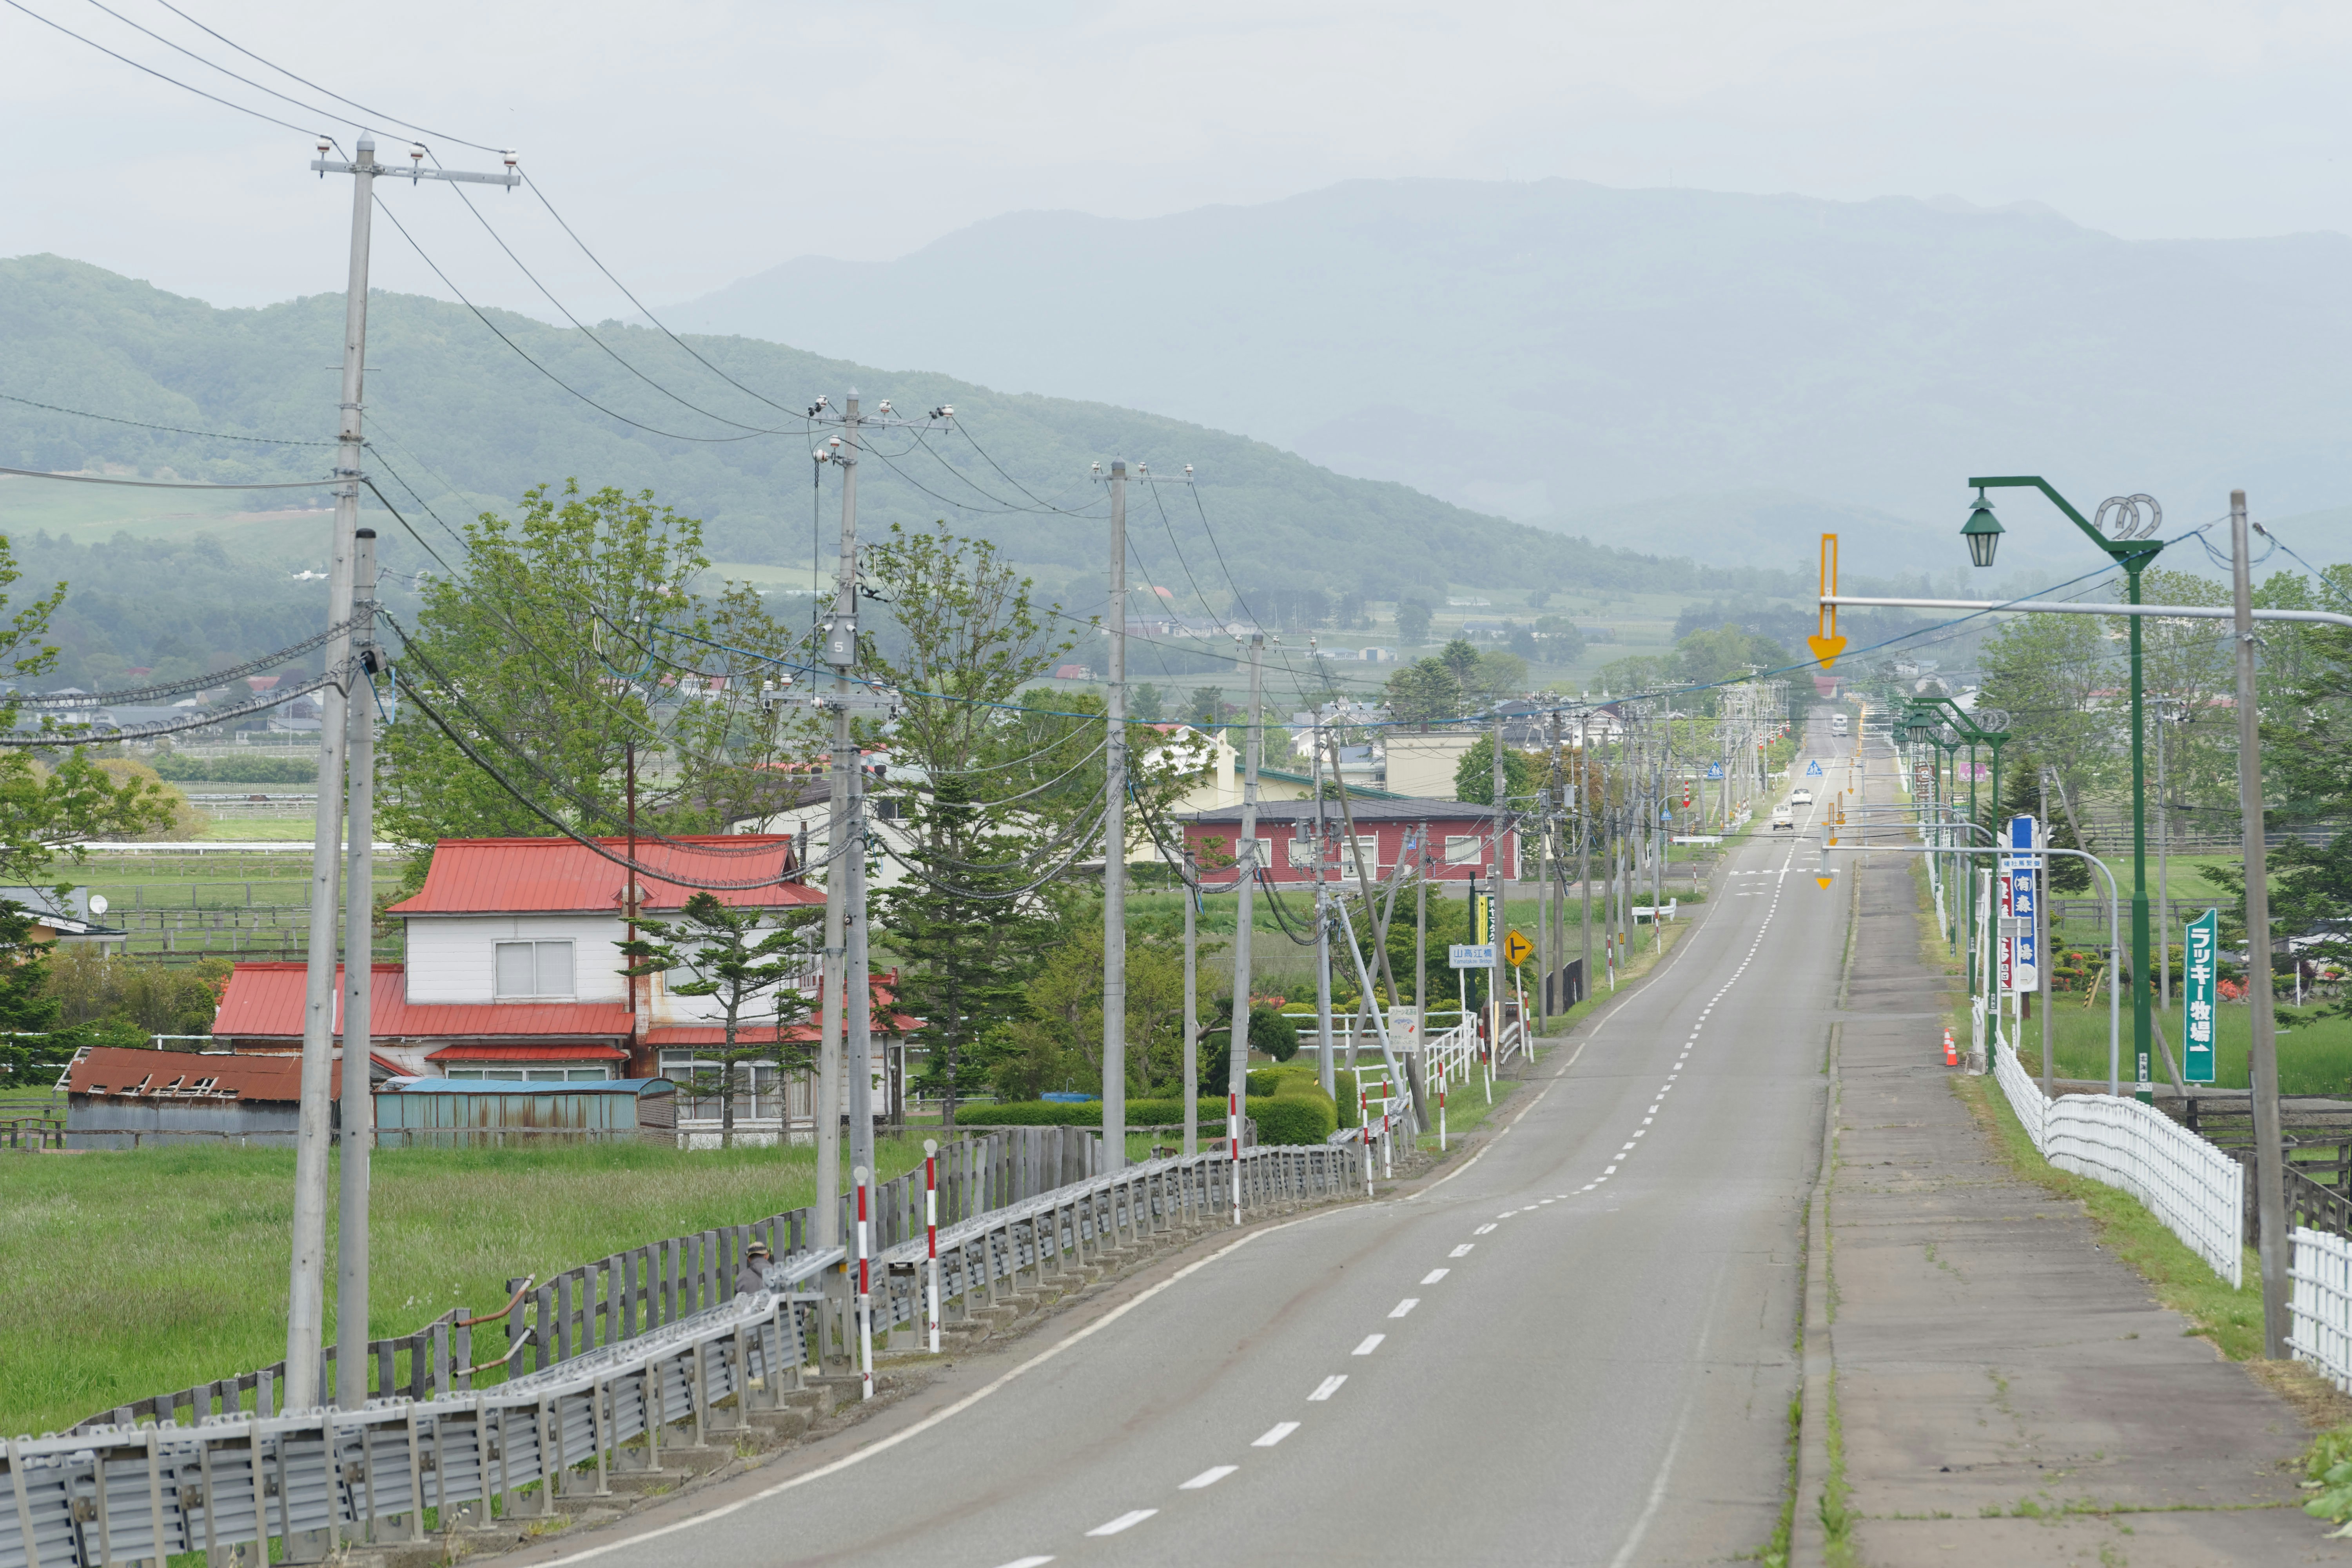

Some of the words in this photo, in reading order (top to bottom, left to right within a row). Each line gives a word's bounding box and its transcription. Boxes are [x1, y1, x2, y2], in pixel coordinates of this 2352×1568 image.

[834, 641, 843, 653] 5
[2014, 875, 2033, 960] (有)森場
[1454, 949, 1492, 958] 山高江橋
